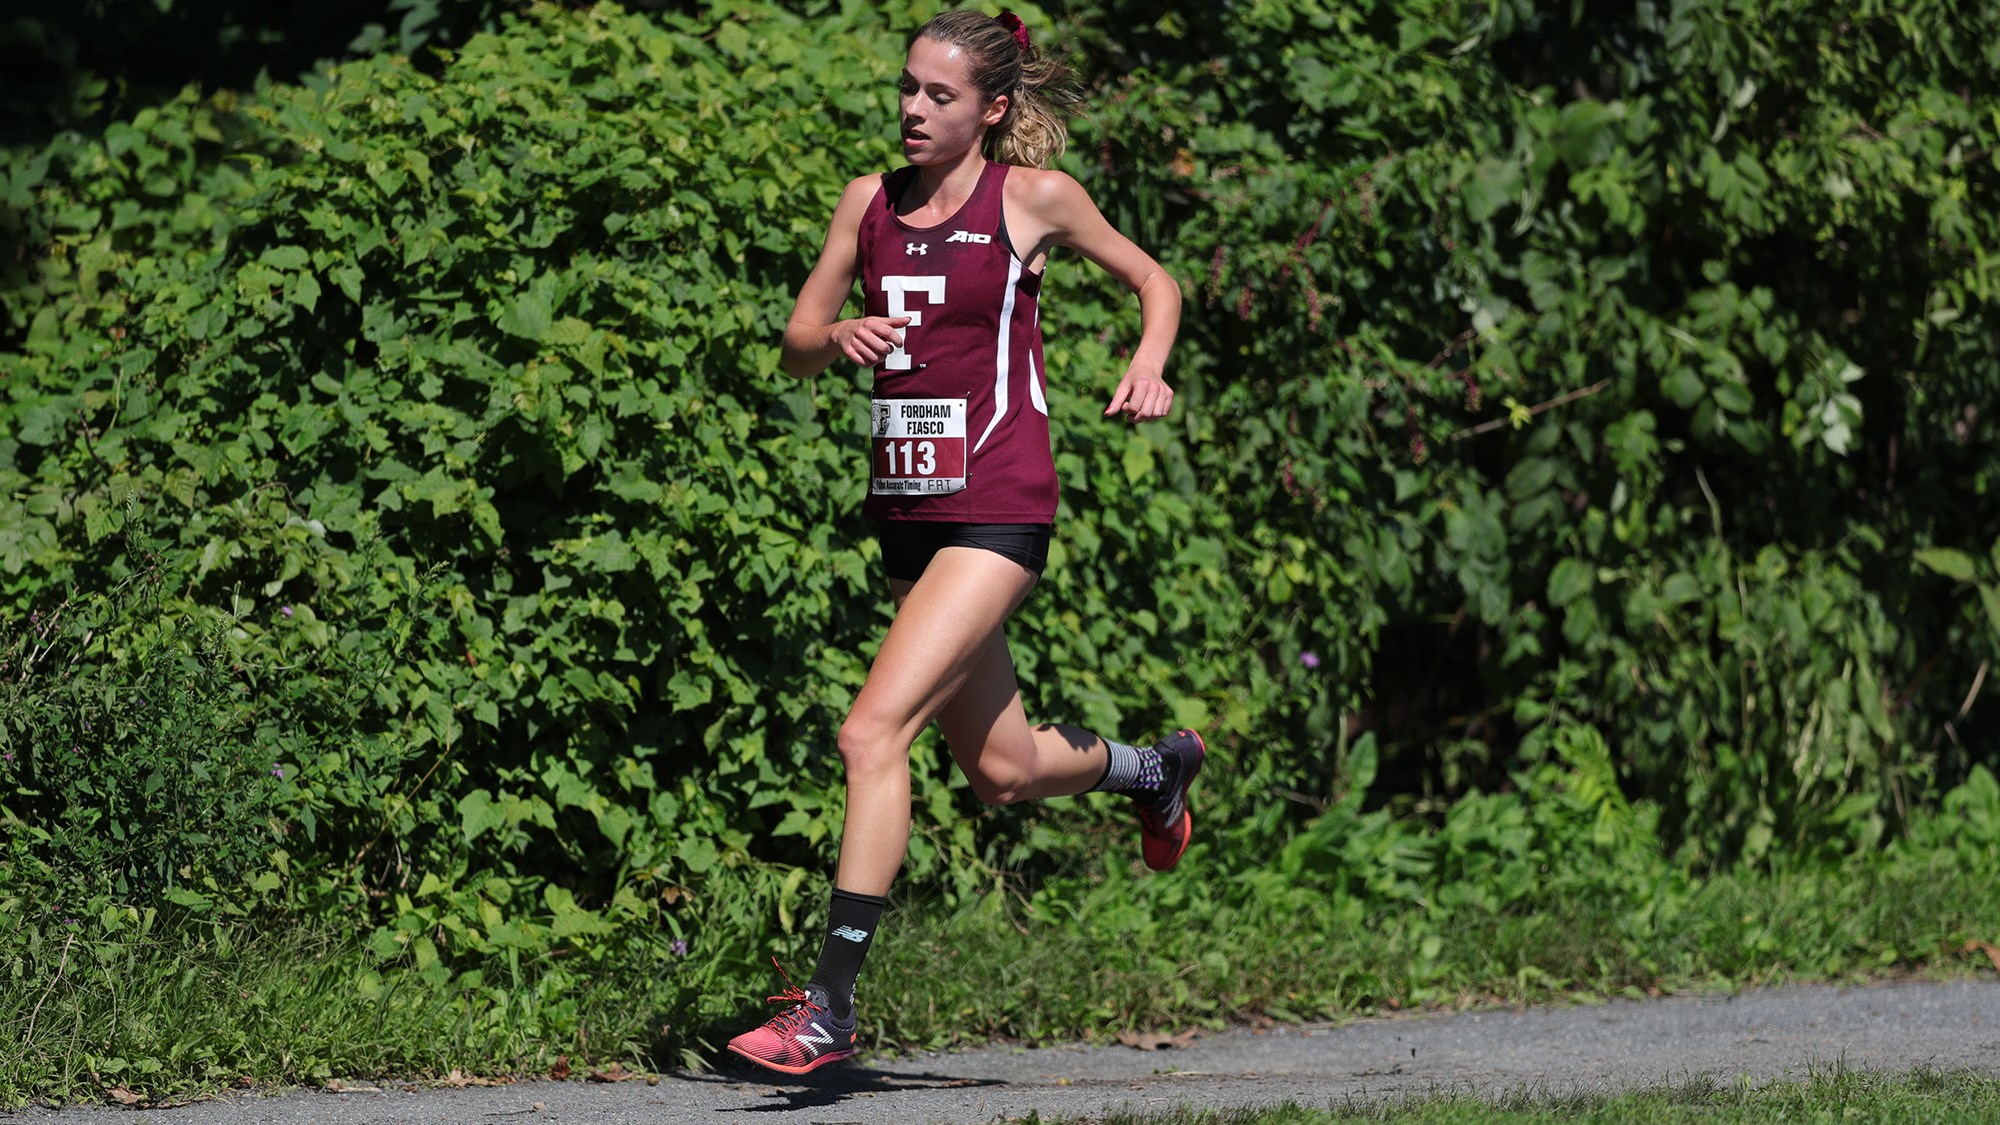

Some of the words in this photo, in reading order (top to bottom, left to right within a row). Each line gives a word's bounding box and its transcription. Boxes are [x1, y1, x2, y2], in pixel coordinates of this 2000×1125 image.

[945, 231, 991, 244] A10
[881, 276, 946, 370] F
[901, 405, 951, 418] FORDHAM
[907, 421, 944, 435] FIASCO
[885, 441, 936, 475] 113
